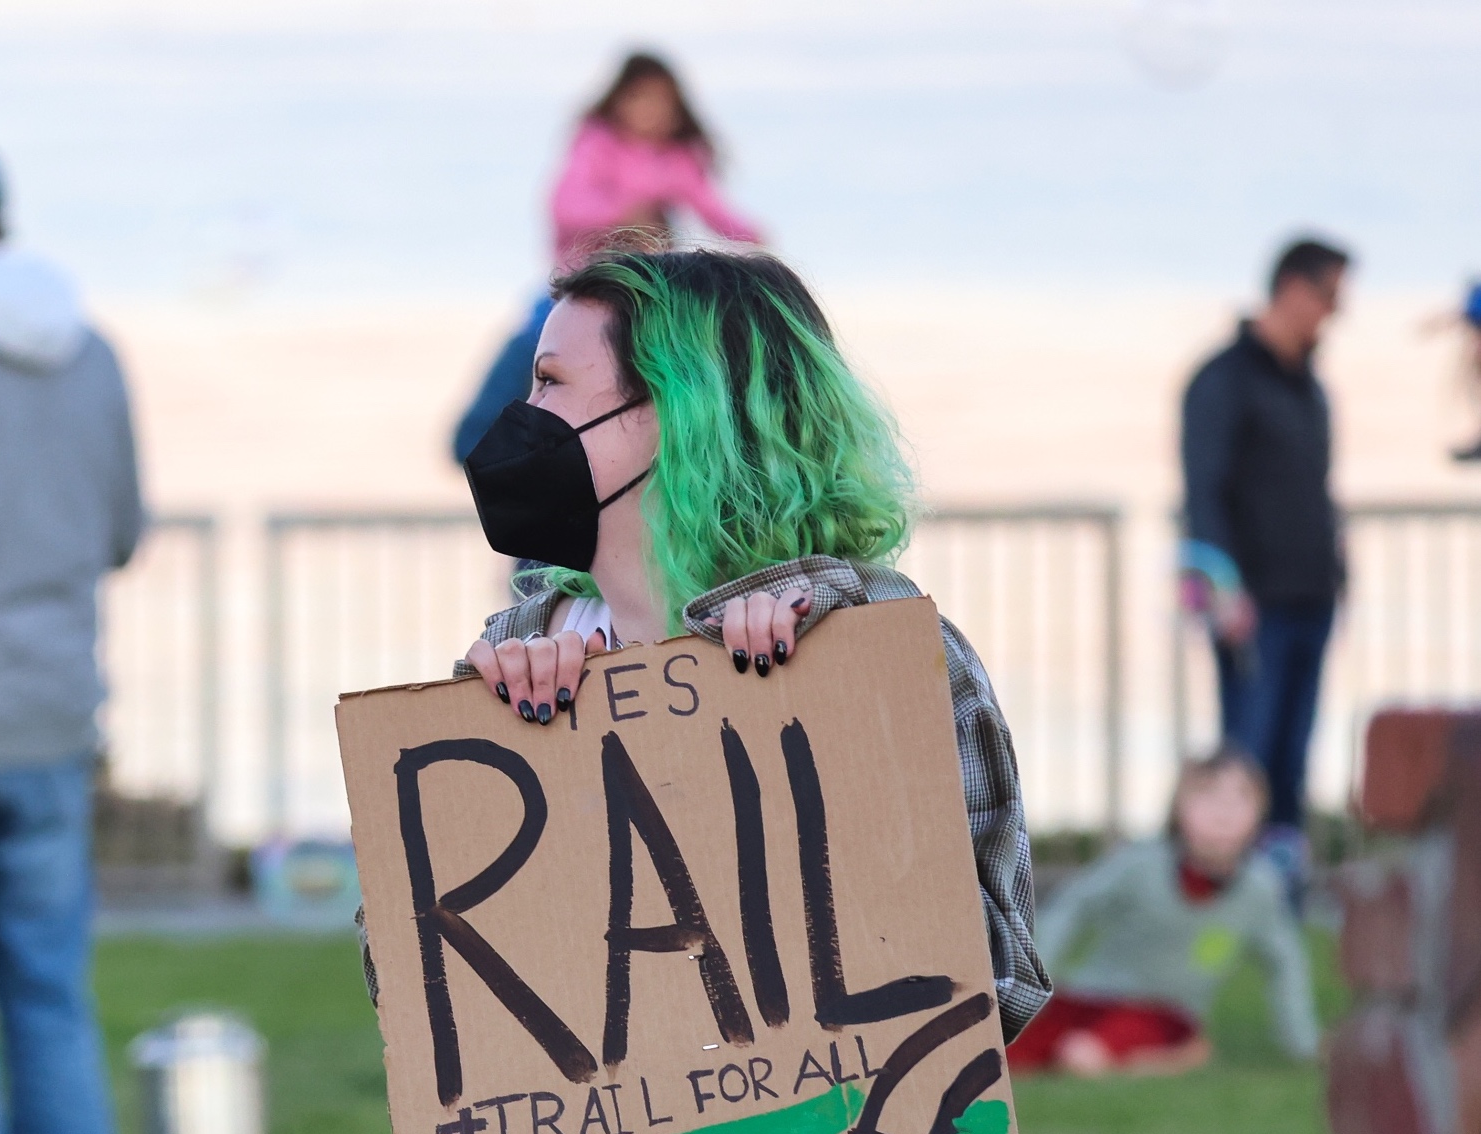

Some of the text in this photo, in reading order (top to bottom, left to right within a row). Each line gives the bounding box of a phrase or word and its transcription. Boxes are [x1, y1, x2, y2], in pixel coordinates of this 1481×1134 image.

[393, 716, 964, 1108] RAIL
[686, 1056, 779, 1114] FOR
[794, 1034, 887, 1095] ALL
